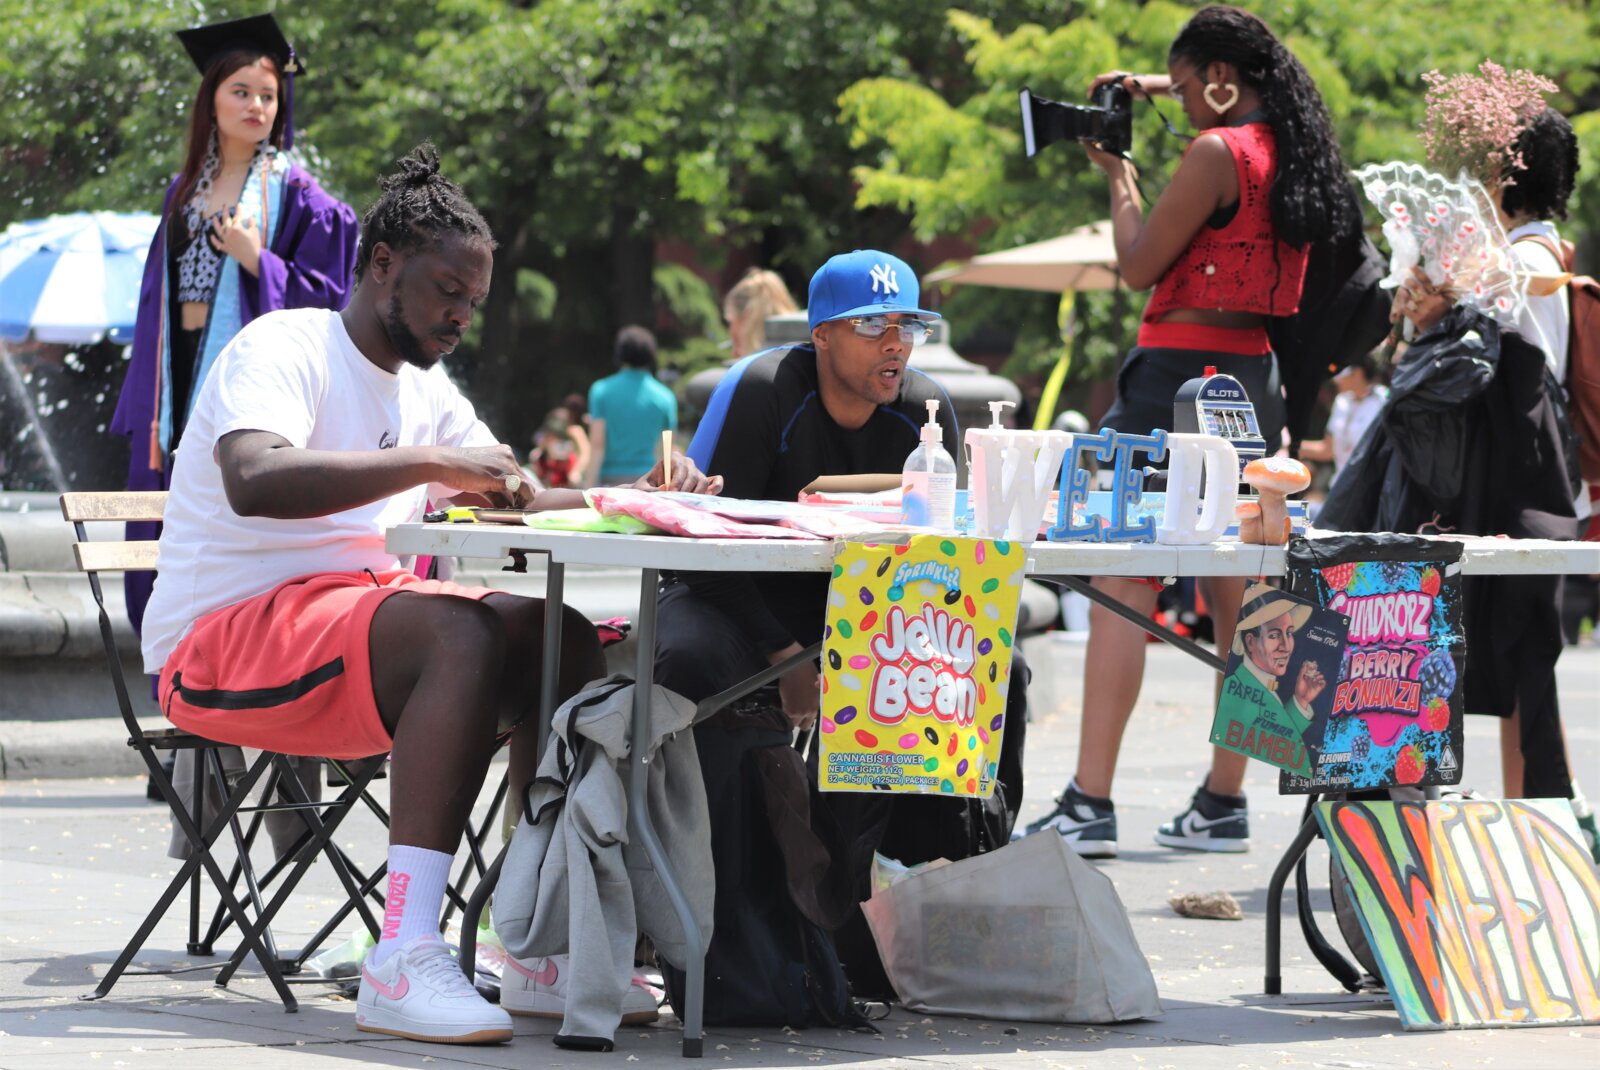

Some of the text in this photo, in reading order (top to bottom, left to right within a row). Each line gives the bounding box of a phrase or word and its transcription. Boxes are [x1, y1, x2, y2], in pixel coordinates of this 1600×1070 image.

[869, 263, 900, 295] NY
[1207, 389, 1240, 398] SLOTS
[965, 427, 1239, 545] WEED
[1350, 649, 1416, 680] BERRY
[871, 663, 977, 727] Bean
[1331, 678, 1422, 715] BONANZA
[1252, 716, 1294, 739] FUMAR
[1263, 709, 1278, 720] DE
[828, 753, 925, 765] CANNABIS FLOWER
[1224, 719, 1307, 770] BAMBU
[1325, 752, 1352, 763] FLOWER
[828, 765, 844, 773] NET
[885, 766, 903, 775] 112g
[828, 775, 838, 783] 32
[905, 777, 939, 785] PACKAGES
[381, 870, 412, 941] STADIUM
[1332, 801, 1600, 1023] WEED
